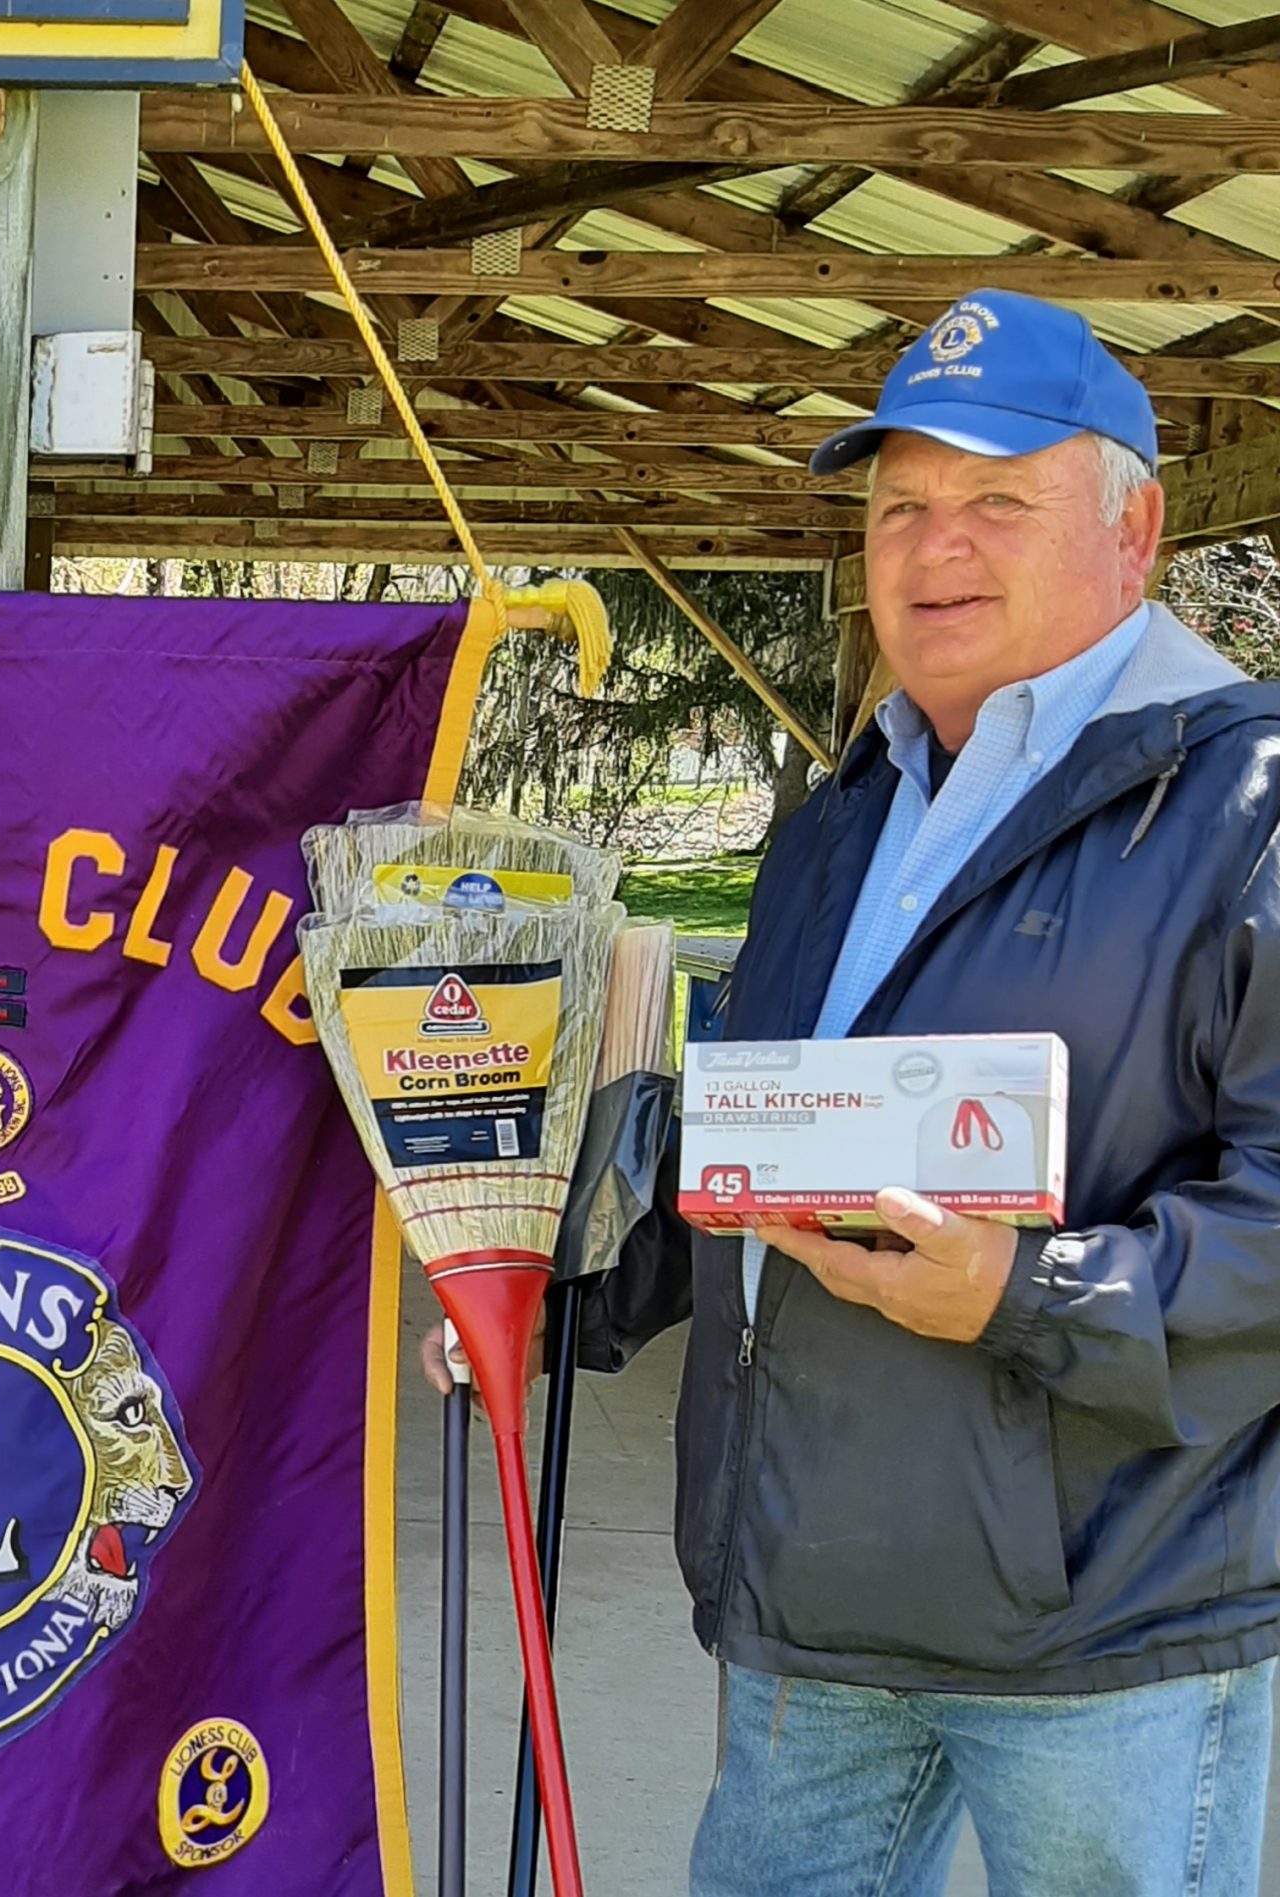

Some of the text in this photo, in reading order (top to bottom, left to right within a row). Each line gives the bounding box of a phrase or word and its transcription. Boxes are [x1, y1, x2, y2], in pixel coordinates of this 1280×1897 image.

[944, 365, 982, 377] CLUB
[434, 1003, 472, 1016] cedar
[385, 1043, 530, 1072] Kleenette
[400, 1071, 520, 1090] Corn Broom
[723, 1080, 781, 1092] GALLON
[705, 1092, 862, 1109] TALL KITCHEN
[703, 1112, 810, 1124] DRAWSTRING
[707, 1173, 742, 1194] 45
[170, 1725, 258, 1777] LIONESS CLUB
[175, 1830, 245, 1862] SPONSOR
